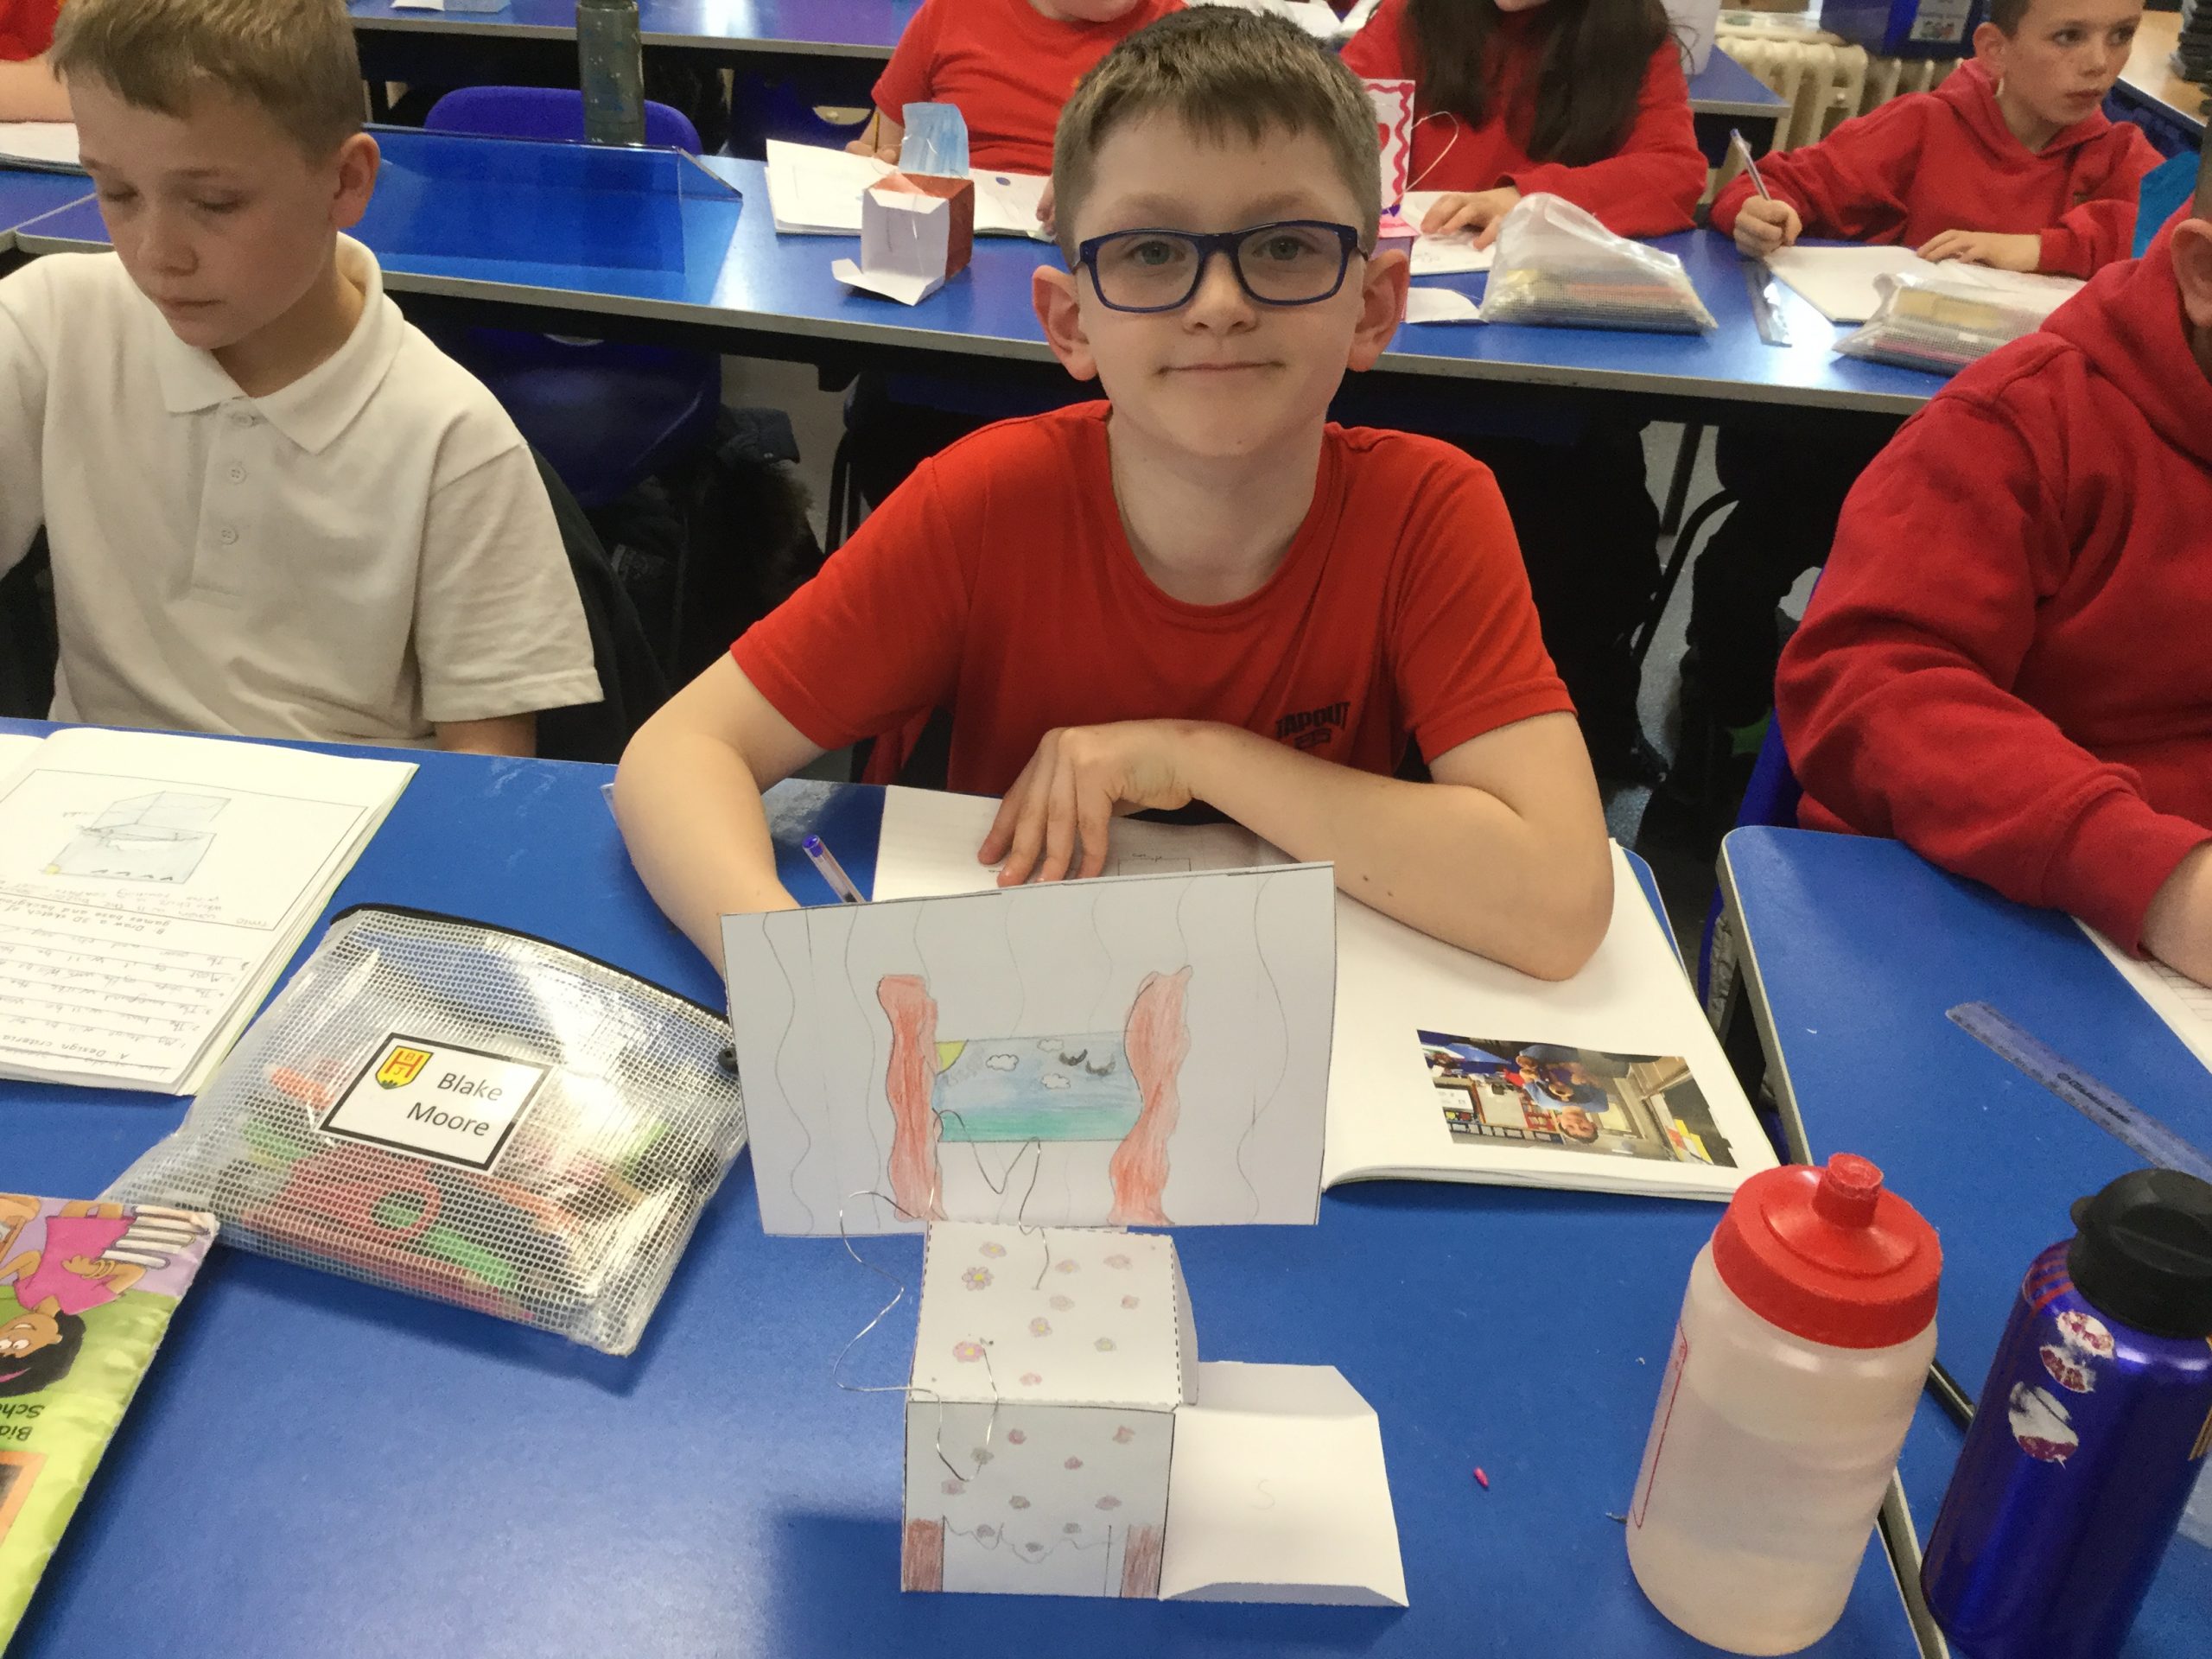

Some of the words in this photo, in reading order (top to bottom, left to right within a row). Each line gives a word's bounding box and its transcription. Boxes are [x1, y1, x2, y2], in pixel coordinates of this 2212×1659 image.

[28, 910, 66, 919] sketch
[113, 923, 144, 932] Draw
[129, 918, 171, 927] games
[2, 1035, 53, 1047] criteria
[61, 1044, 106, 1058] Design
[437, 1072, 503, 1102] Blake
[407, 1102, 490, 1136] Moore
[0, 1403, 46, 1419] Sch
